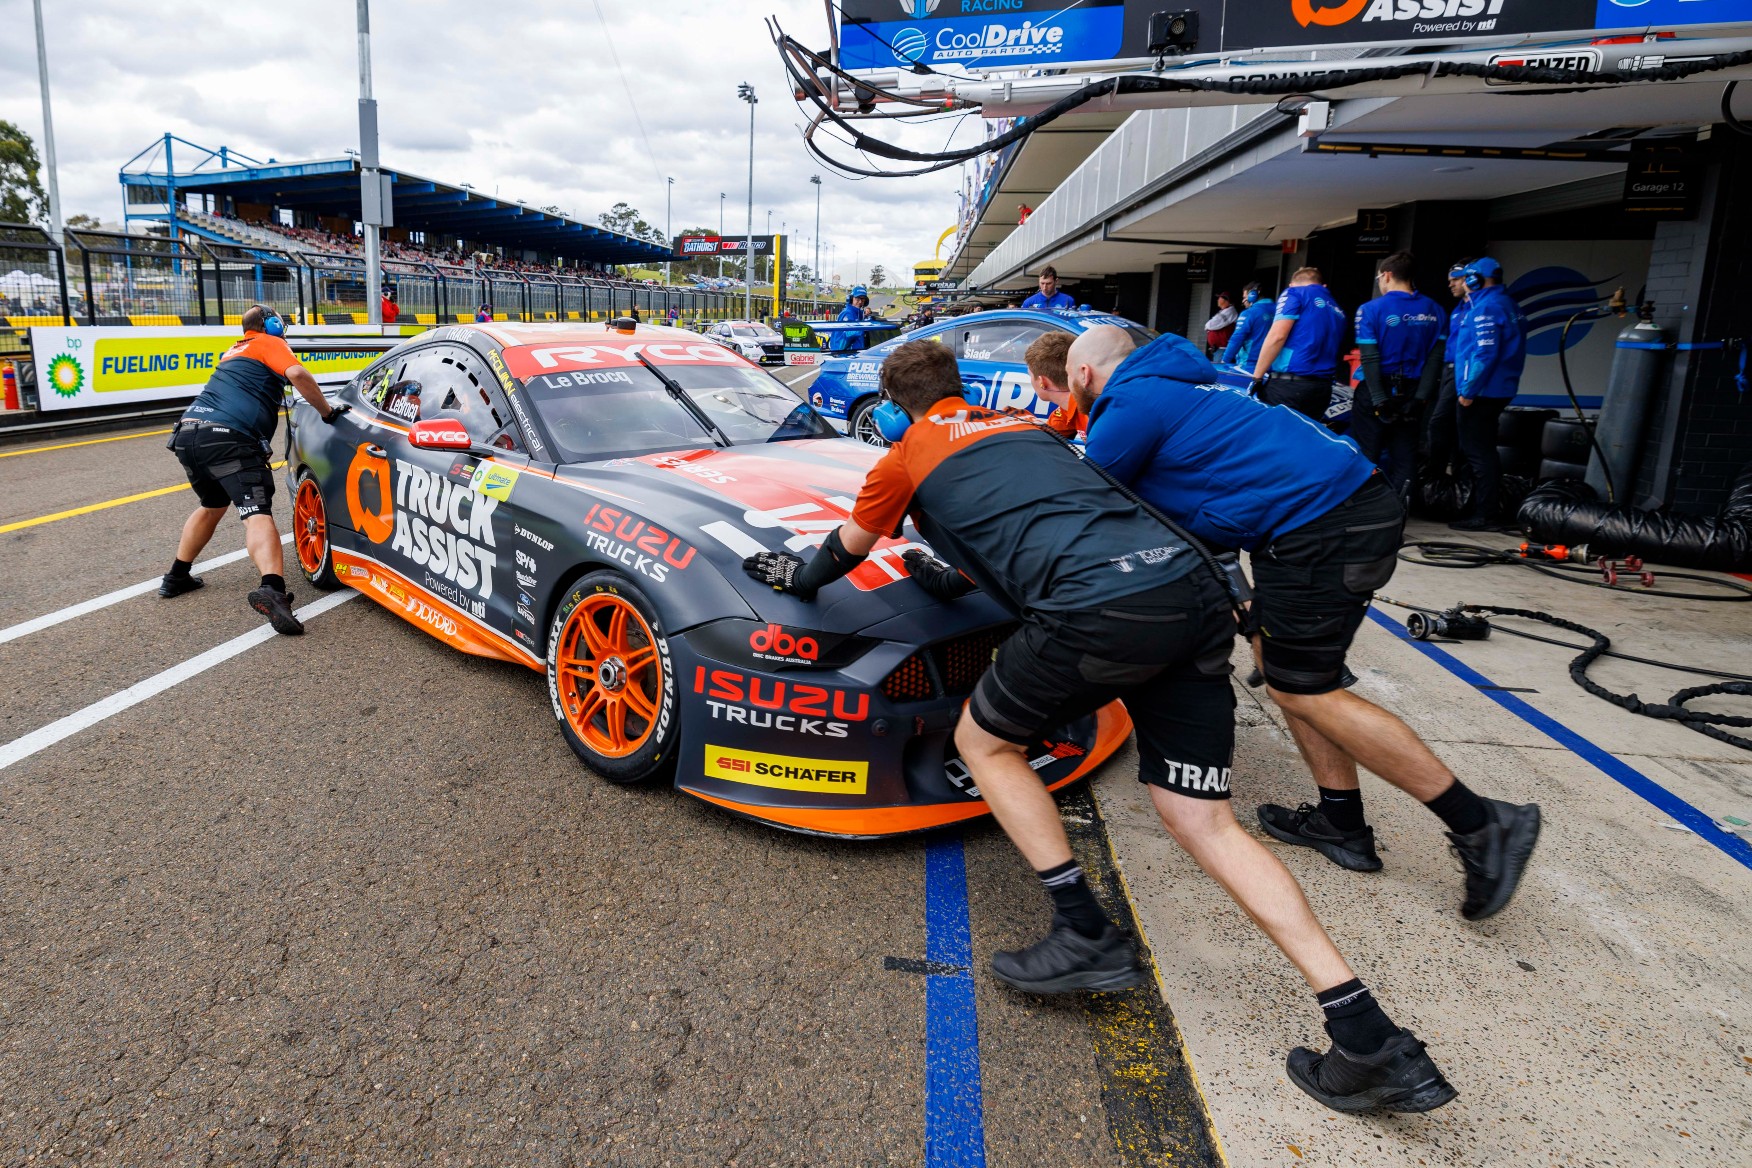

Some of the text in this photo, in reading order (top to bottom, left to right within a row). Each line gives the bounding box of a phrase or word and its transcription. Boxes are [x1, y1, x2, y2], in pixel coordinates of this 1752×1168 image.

[961, 0, 1023, 12] RACING
[936, 20, 1064, 48] CoolDrive
[1412, 18, 1497, 33] Powered by nti
[937, 46, 1026, 58] AUTO PARTS
[1632, 182, 1684, 193] Garage 12
[1364, 214, 1387, 230] 13
[683, 241, 719, 253] BATHURST
[66, 336, 83, 351] bp
[446, 327, 476, 343] TRADIE
[102, 353, 179, 375] FUELING
[185, 352, 214, 370] THE
[531, 343, 736, 369] RYCO
[790, 353, 815, 363] Gabriel
[964, 348, 991, 360] Slade
[541, 371, 634, 390] Le Brocq
[847, 372, 878, 381] BREWING
[510, 394, 544, 452] electrical
[415, 430, 469, 444] RYCO
[488, 472, 511, 486] ultimate
[396, 458, 499, 547] TRUCK
[520, 527, 554, 552] DUNLOP
[583, 503, 698, 570] ISUZU
[391, 509, 497, 599] ASSIST
[585, 530, 670, 583] TRUCKS
[425, 571, 458, 604] Powered
[459, 588, 471, 612] by
[471, 601, 486, 619] nti
[749, 623, 819, 661] dba
[656, 637, 674, 744] DUNLOP
[693, 665, 870, 722] ISUZU
[706, 700, 849, 738] TRUCKS
[716, 756, 856, 784] SSI SCHÄFER
